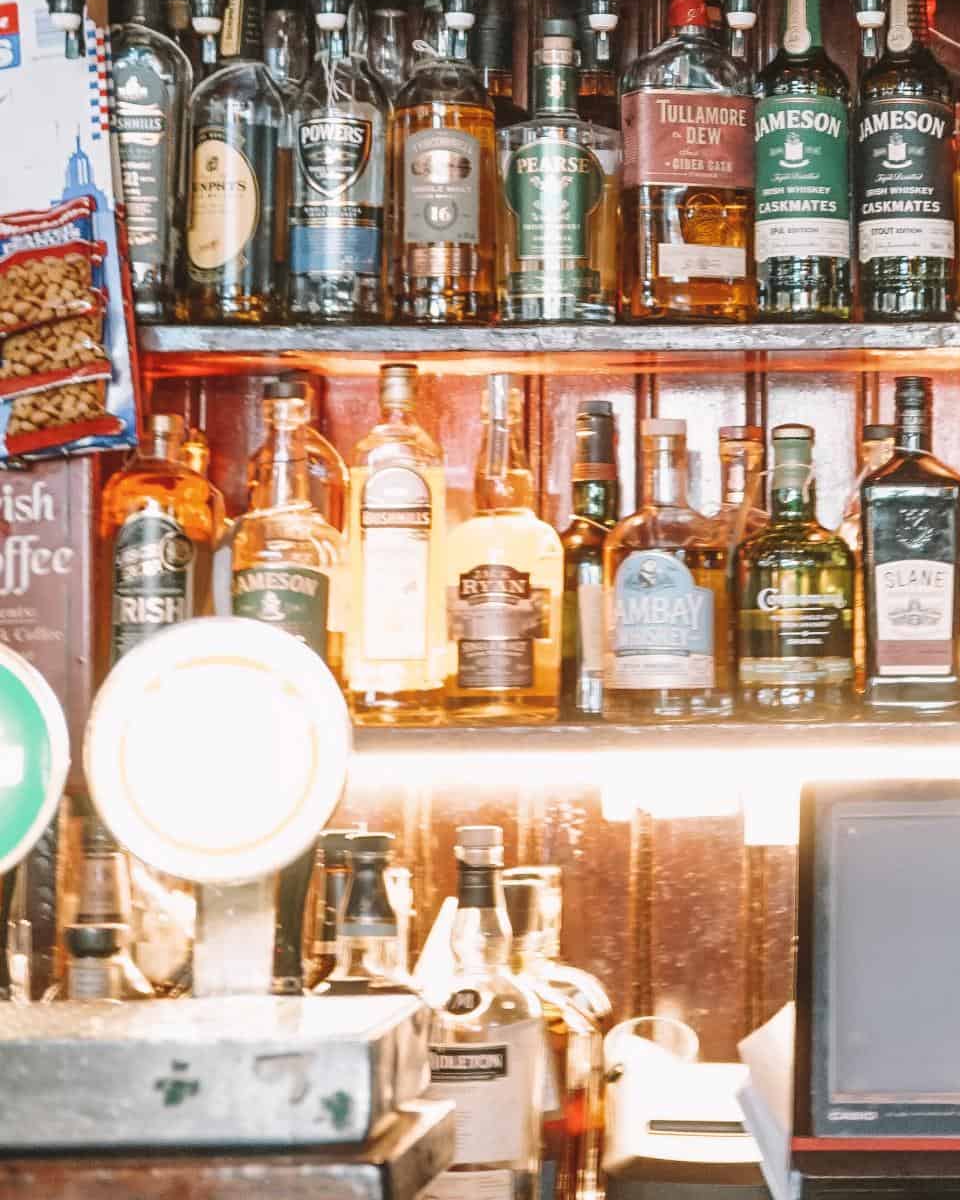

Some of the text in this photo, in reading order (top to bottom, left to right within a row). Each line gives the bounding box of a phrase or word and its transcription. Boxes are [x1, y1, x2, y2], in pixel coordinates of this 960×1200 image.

[656, 99, 748, 127] TULLAMORE
[117, 117, 162, 131] SHMILLS
[754, 110, 842, 142] JAMESON
[858, 110, 946, 142] JAMESON
[301, 126, 364, 145] POWERS
[686, 127, 721, 145] DEW
[516, 157, 590, 174] PEARSE
[787, 186, 831, 195] WHISKEY
[890, 186, 935, 196] WHISKEY
[430, 206, 449, 222] 16
[759, 200, 837, 213] CASKMATES
[863, 201, 942, 214] CASKMATES
[461, 578, 527, 595] RYAN
[883, 570, 945, 589] SLANE
[613, 590, 705, 630] AMBAY
